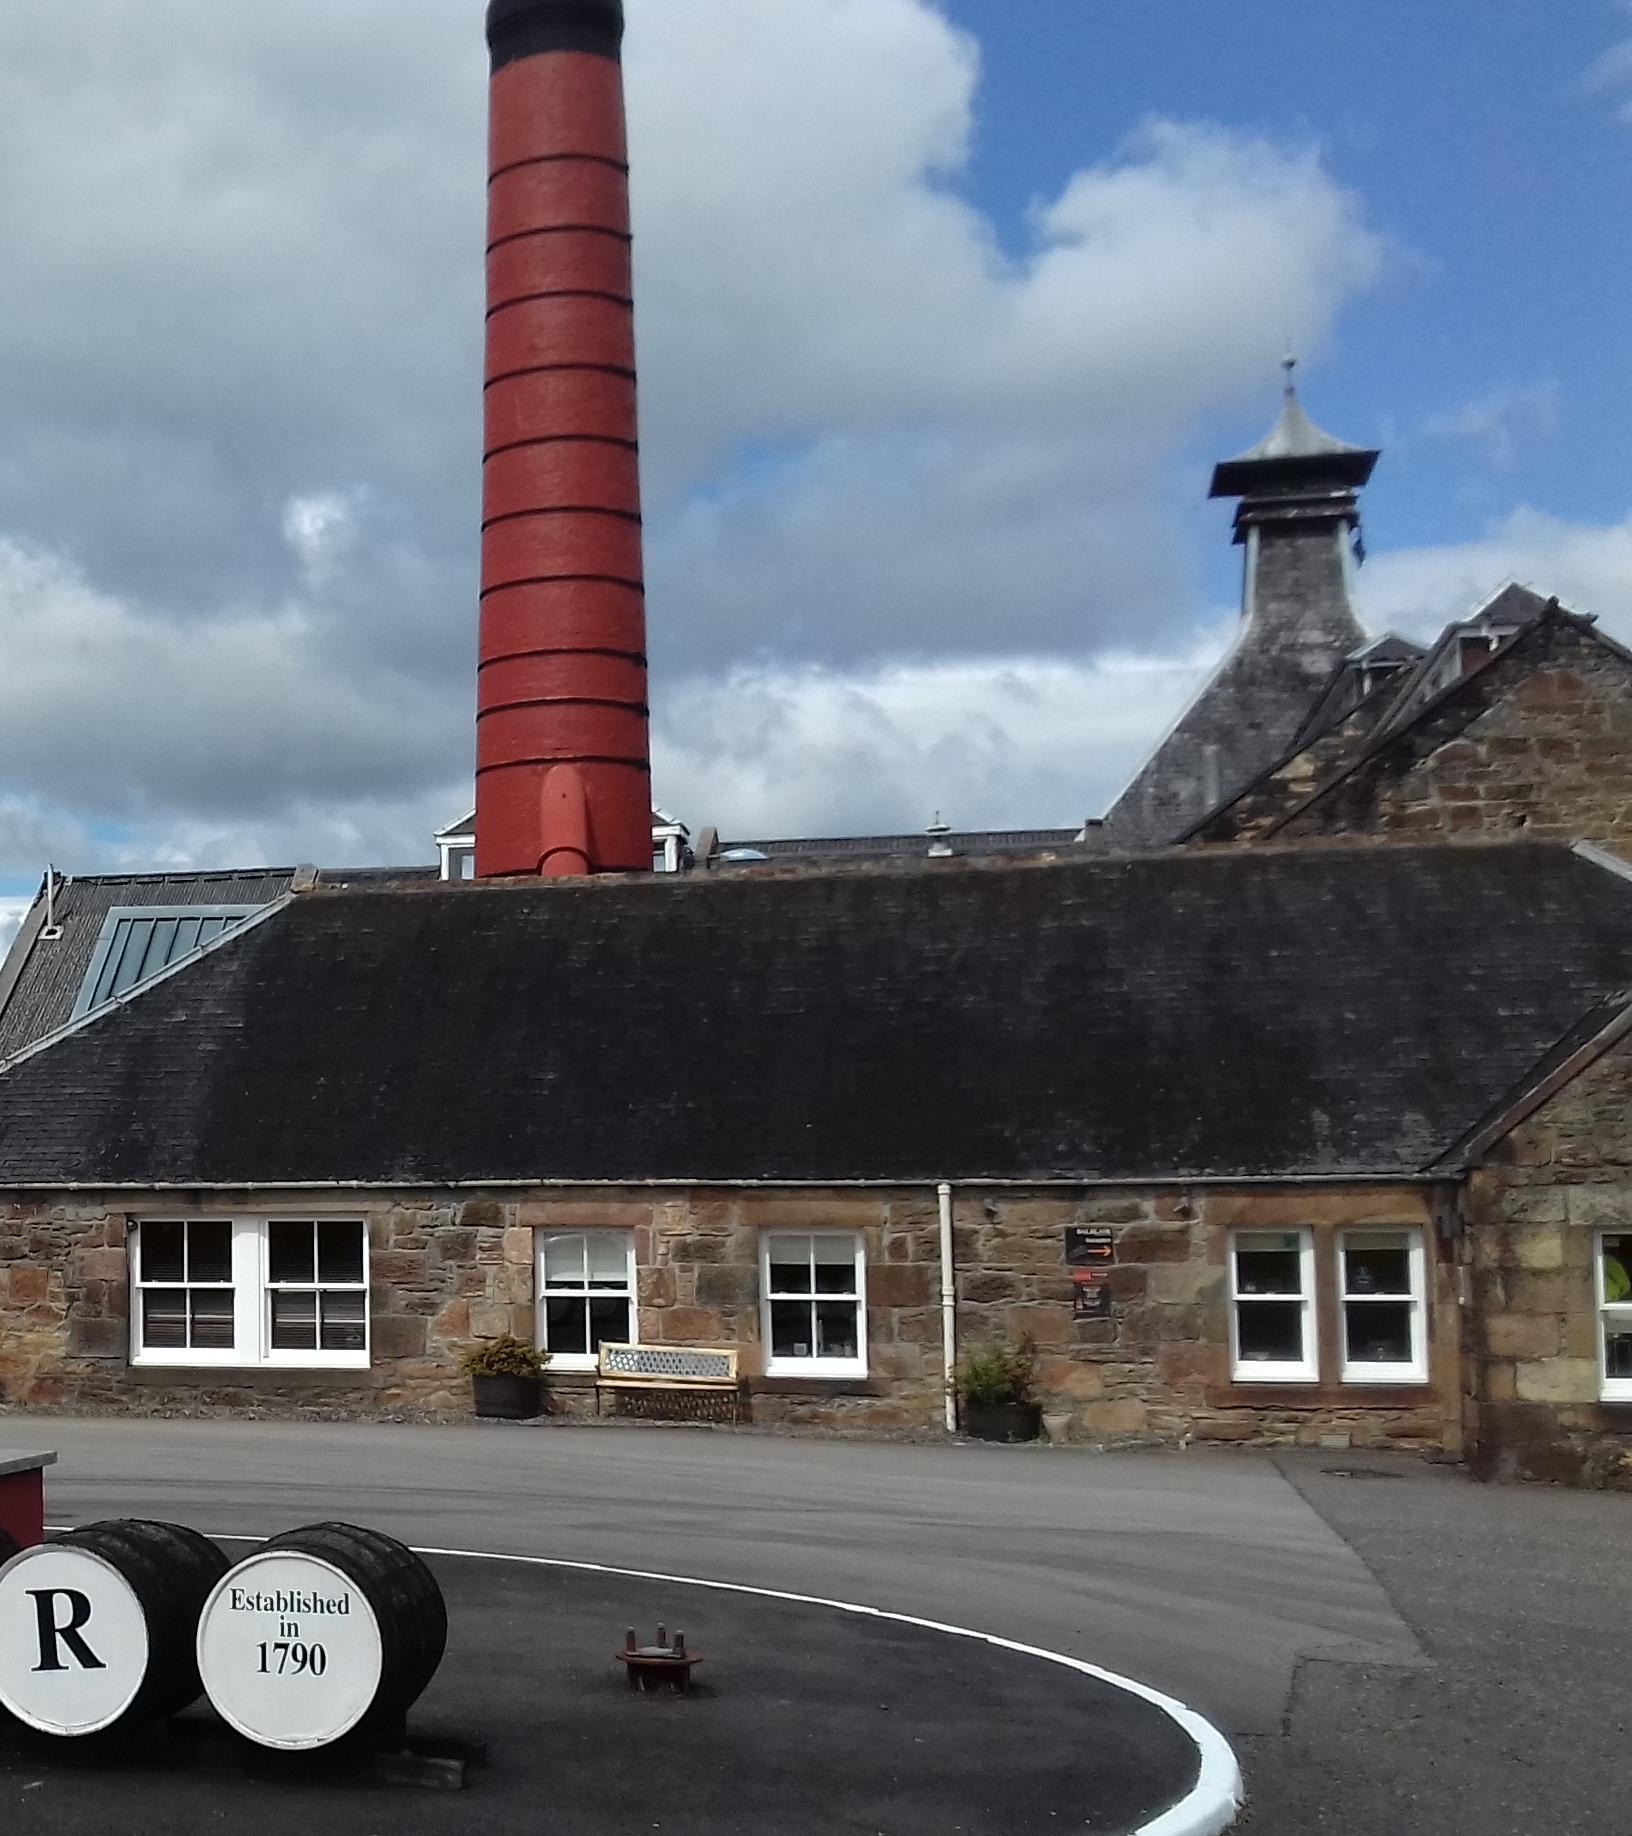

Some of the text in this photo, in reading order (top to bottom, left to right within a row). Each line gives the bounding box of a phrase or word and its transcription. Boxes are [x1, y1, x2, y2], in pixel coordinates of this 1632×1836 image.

[229, 1587, 350, 1615] Established
[279, 1614, 300, 1638] in
[256, 1641, 327, 1676] 1790
